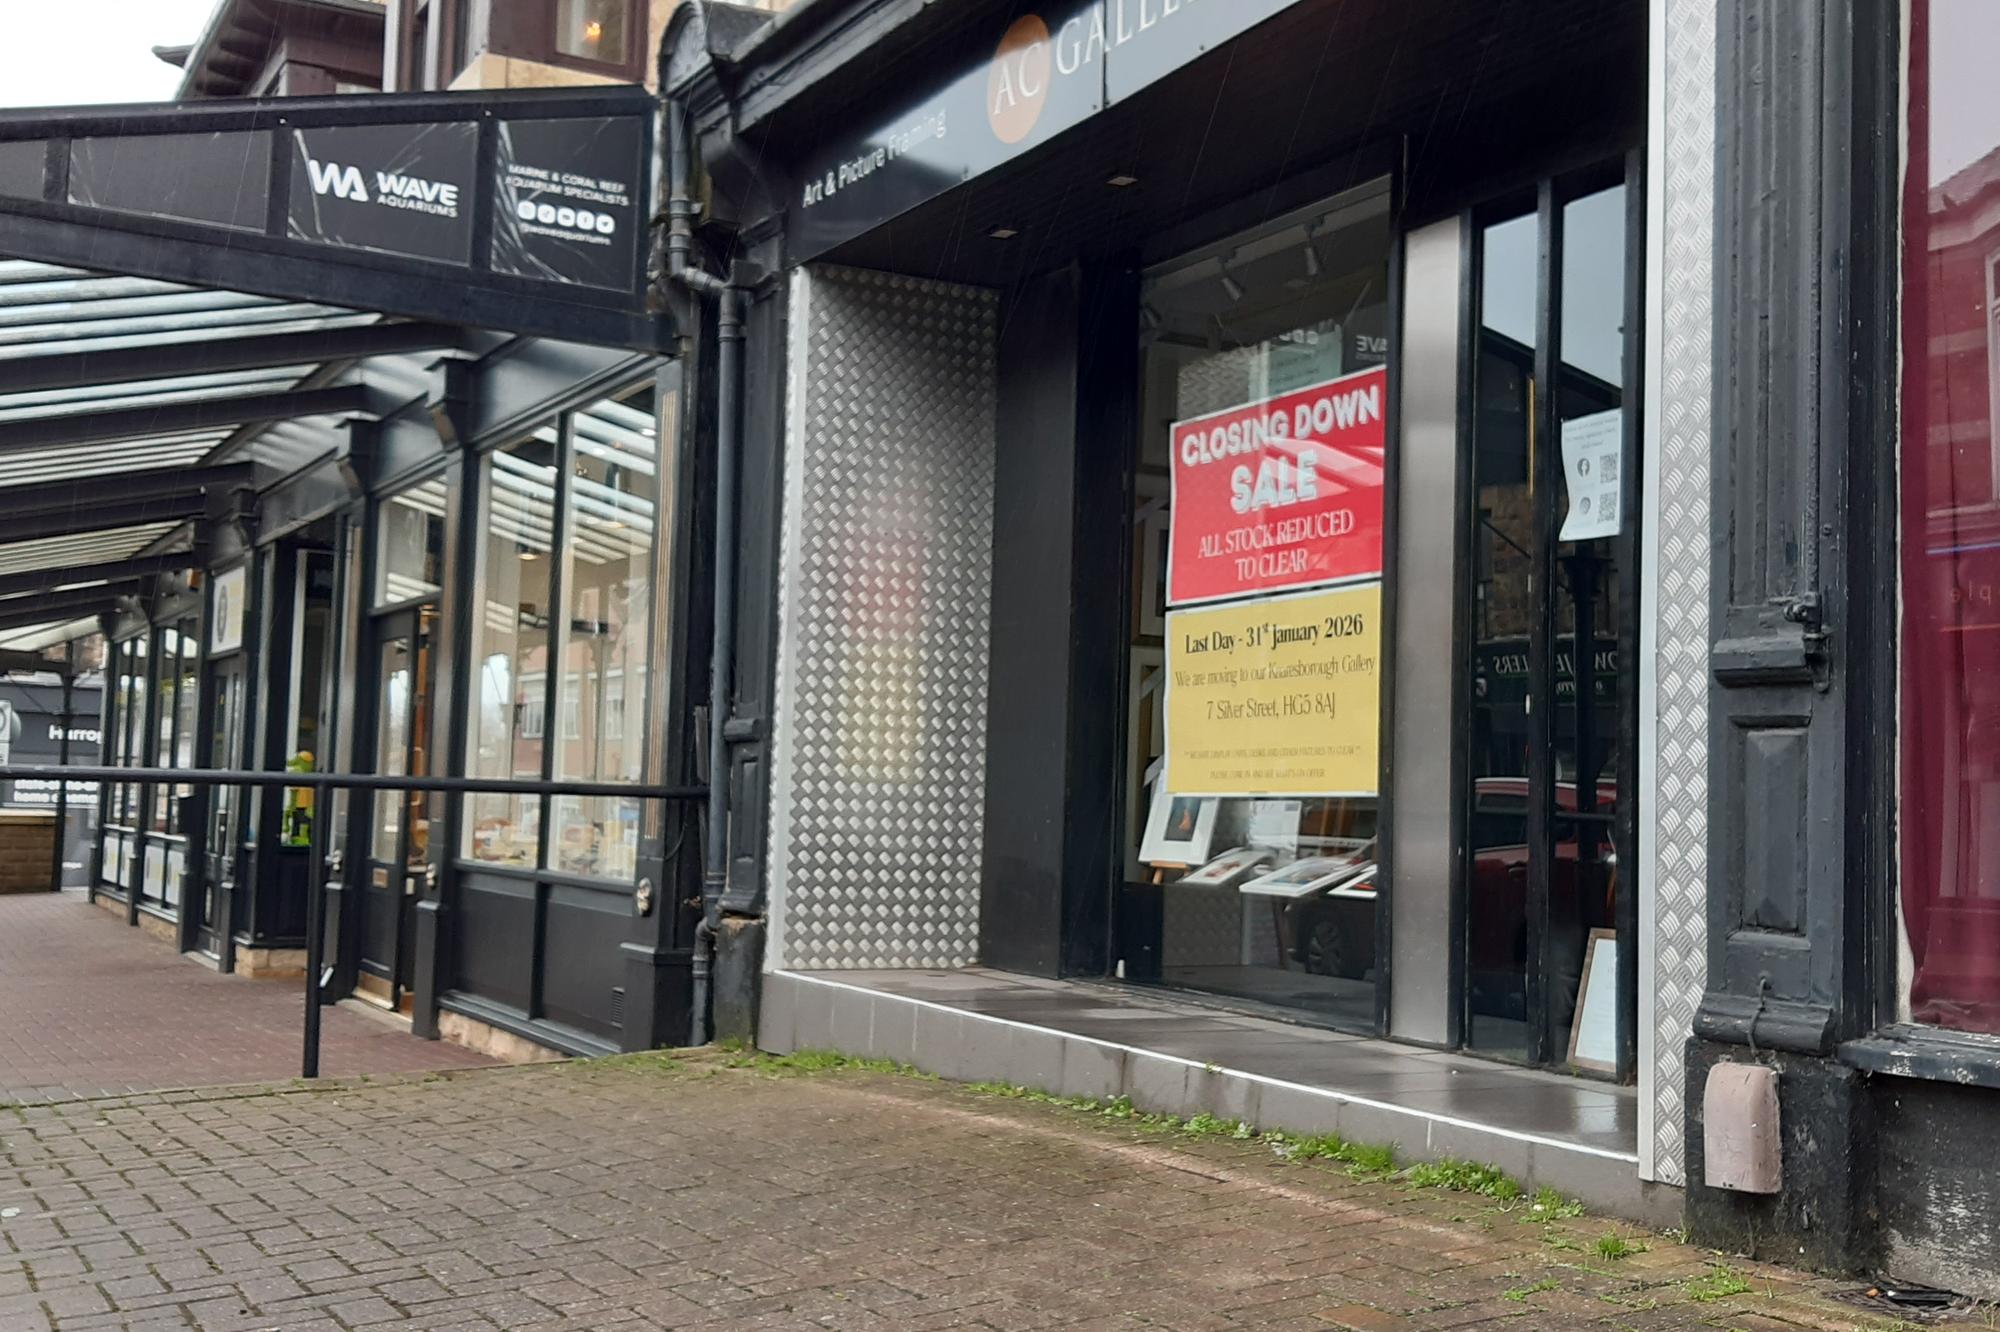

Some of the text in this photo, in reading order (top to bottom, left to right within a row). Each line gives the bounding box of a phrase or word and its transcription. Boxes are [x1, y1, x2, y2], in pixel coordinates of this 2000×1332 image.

[992, 0, 1194, 116] AC GALL
[802, 109, 946, 208] Art & Picture Frag
[308, 159, 369, 202] WA
[376, 171, 459, 206] WAVE
[505, 176, 629, 206] AQUARIUM SPECIALISTS
[509, 164, 626, 193] MARINE & CORAL REEF
[377, 194, 458, 218] AQUARIUMS
[1181, 385, 1380, 467] CLOSING DOWN
[1230, 450, 1318, 514] SALE
[1198, 508, 1355, 559] ALL STOCK REDUCED
[1236, 548, 1309, 581] TO CLEAR
[1186, 634, 1208, 654] Last
[1212, 631, 1235, 655] Day
[1246, 622, 1269, 647] 31st
[1271, 623, 1319, 650] January
[1324, 613, 1364, 639] 2026
[1175, 670, 1190, 687] We
[1192, 673, 1206, 686] are
[1207, 666, 1239, 687] moving
[1240, 667, 1249, 681] to
[1251, 667, 1267, 681] our
[1342, 654, 1376, 676] Gallery
[1206, 701, 1213, 720] 7
[1217, 700, 1245, 720] Silver
[1283, 694, 1311, 717] HG5
[1315, 692, 1336, 720] 8AJ
